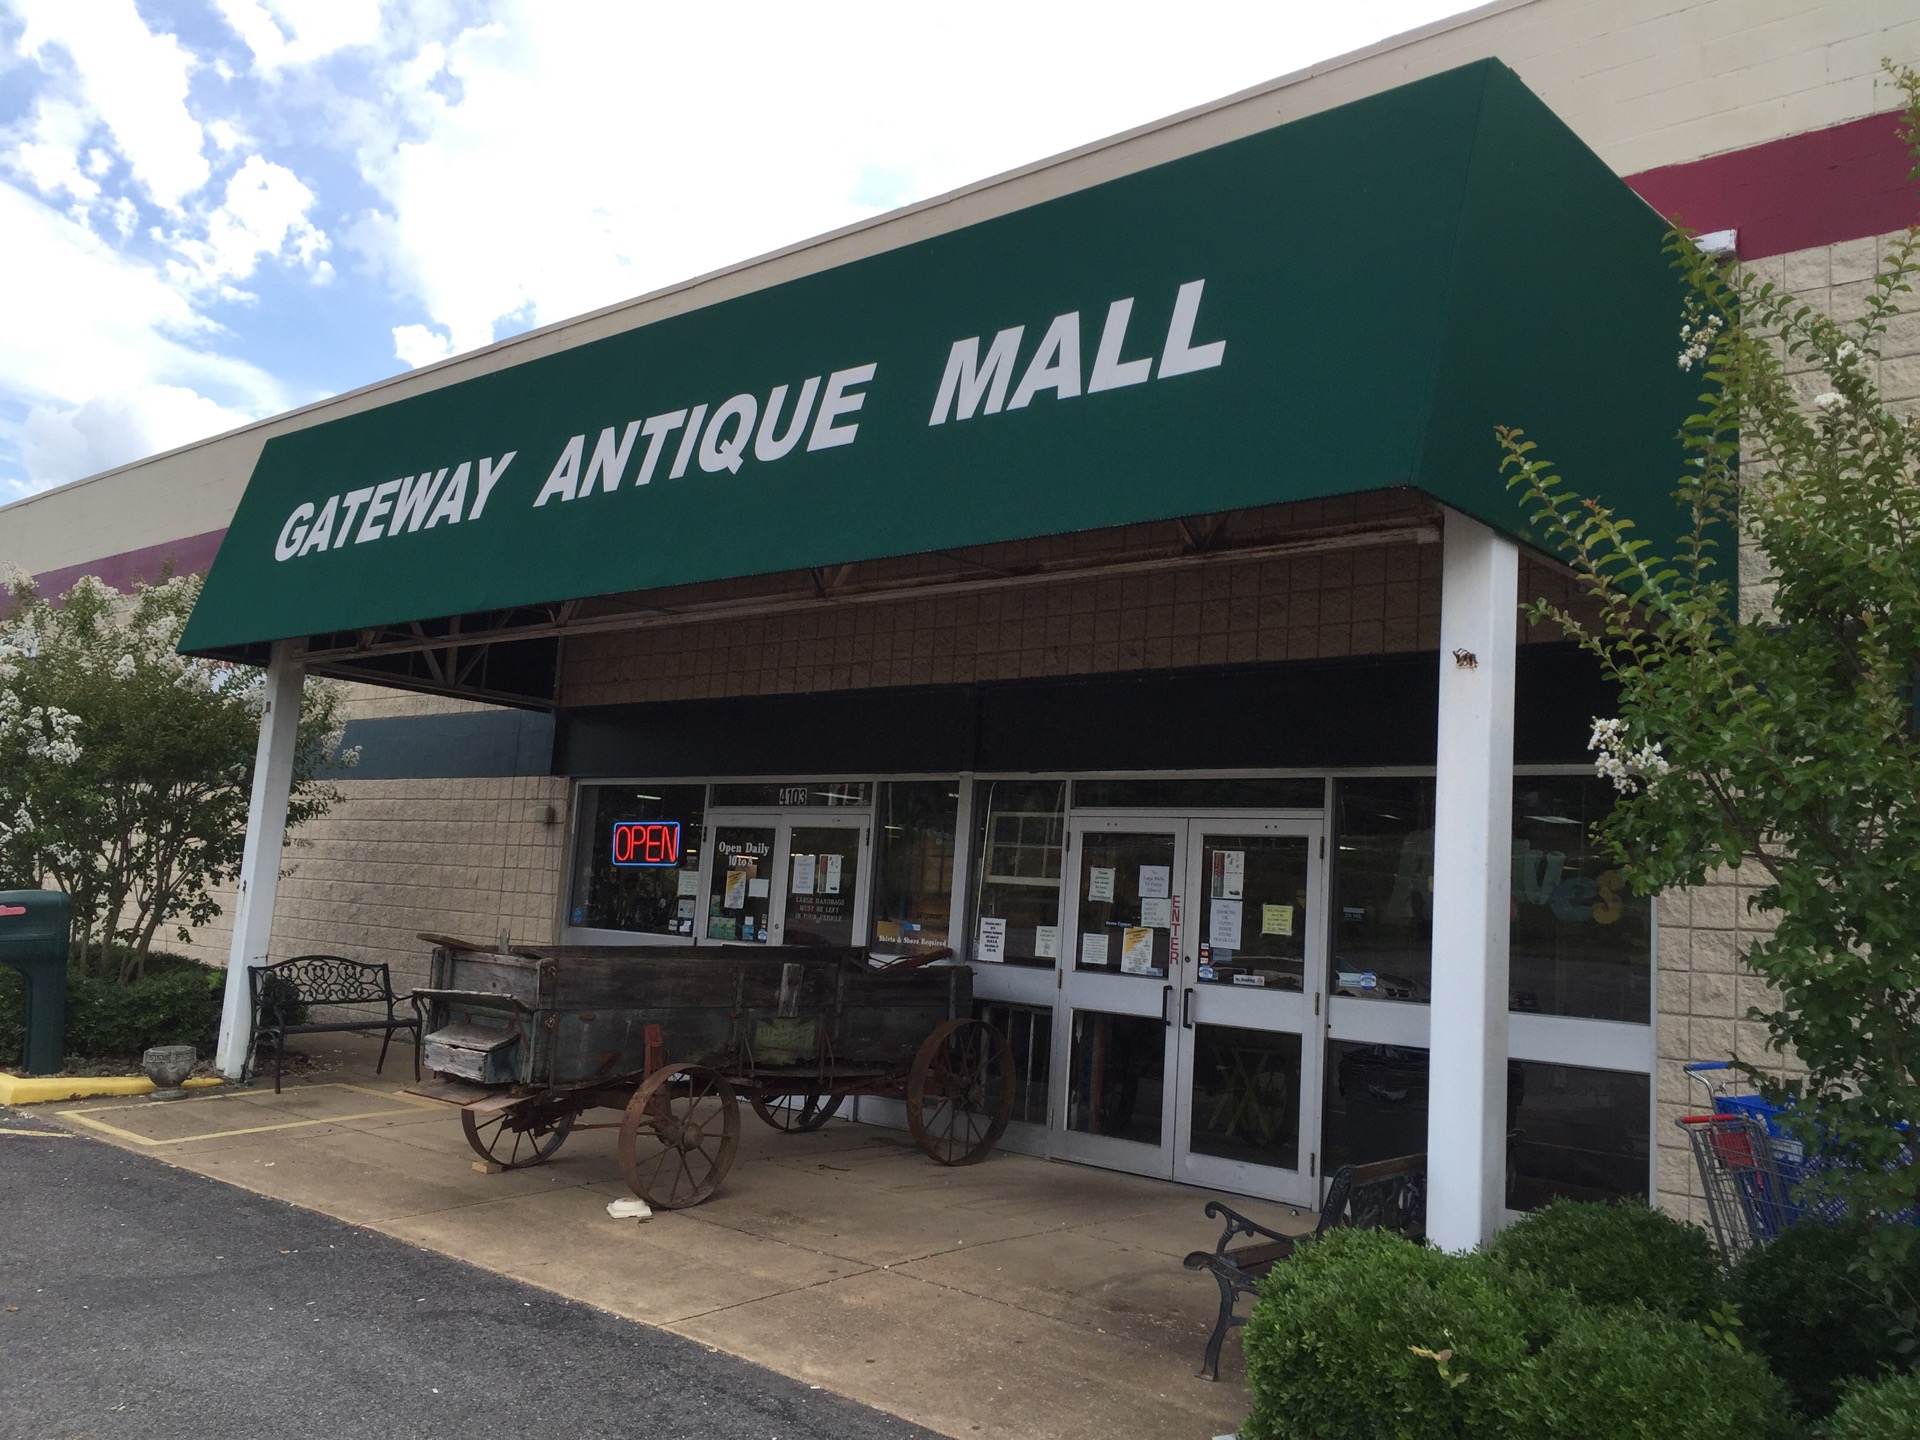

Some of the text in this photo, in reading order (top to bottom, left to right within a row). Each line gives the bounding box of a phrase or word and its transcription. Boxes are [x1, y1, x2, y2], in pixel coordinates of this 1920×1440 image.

[275, 279, 1227, 562] GATEWAY ANTIQUE MALL
[779, 788, 807, 805] 4103
[616, 825, 678, 862] OPEN
[718, 841, 770, 856] Open Daily
[728, 855, 737, 867] 10
[738, 857, 747, 867] to
[815, 898, 845, 906] HANDBAGS
[1170, 895, 1180, 965] ENTER
[878, 935, 896, 943] Shirts
[903, 936, 919, 944] Shoes
[921, 938, 947, 947] Required
